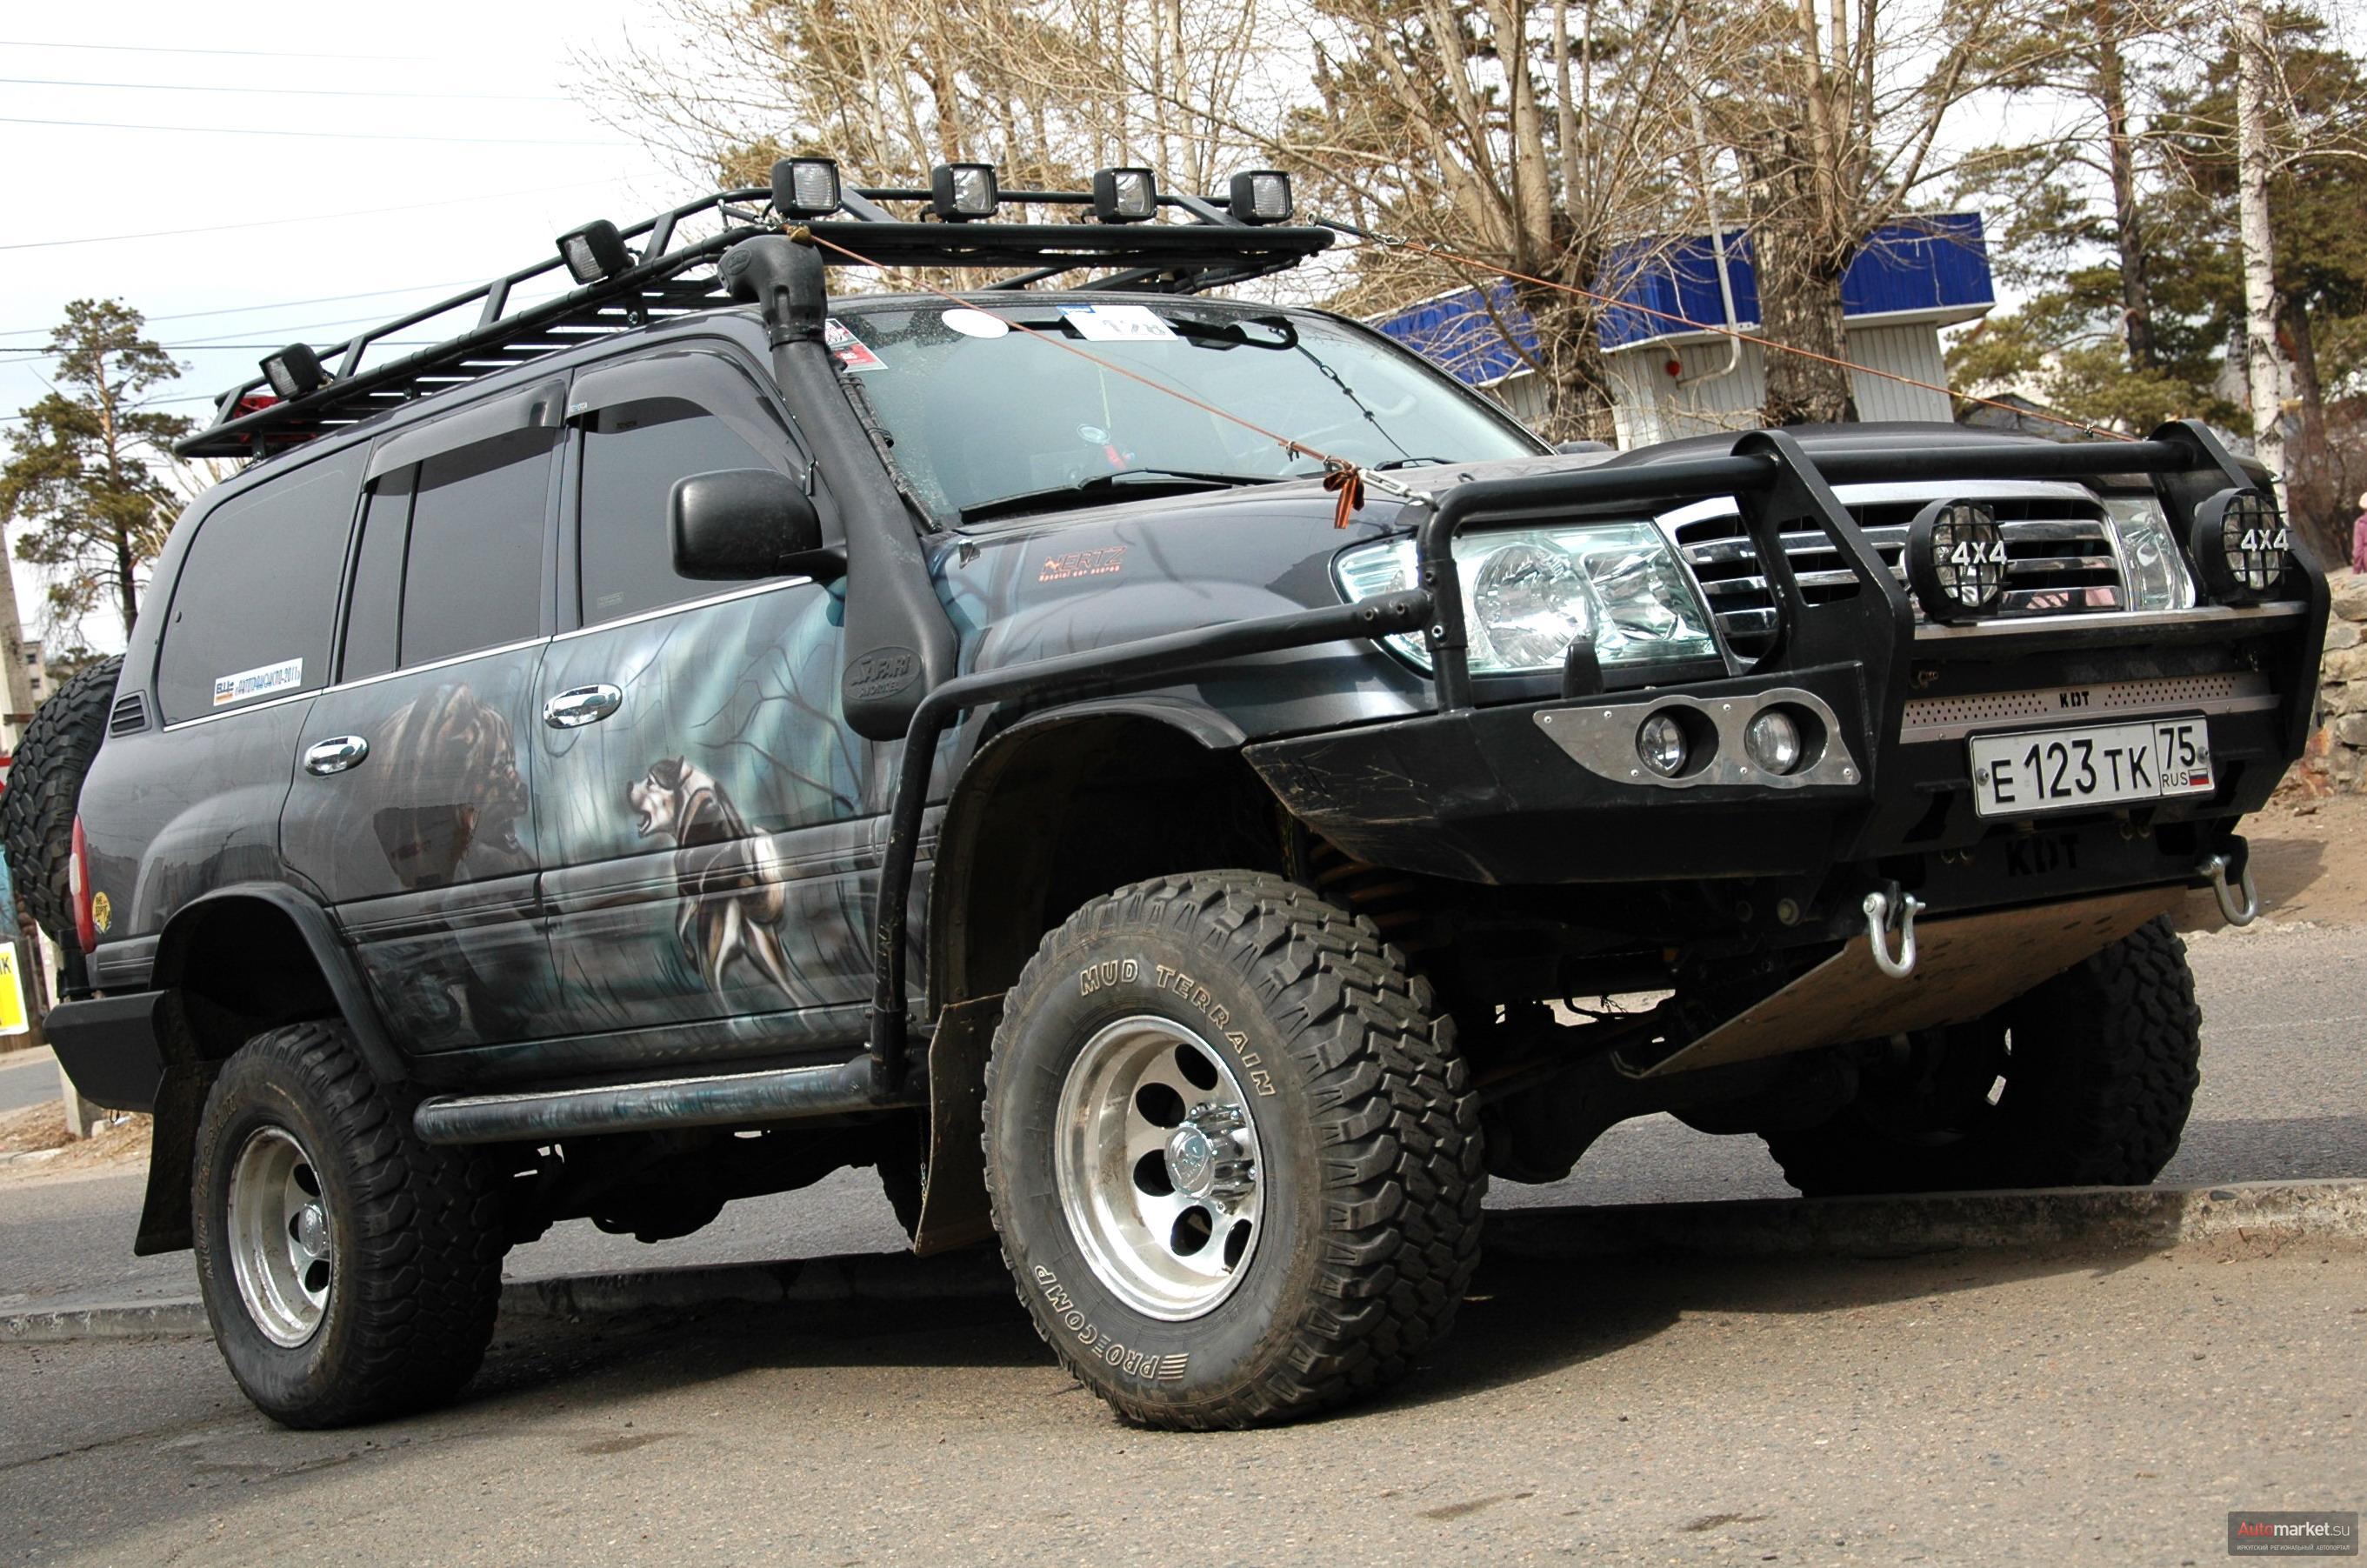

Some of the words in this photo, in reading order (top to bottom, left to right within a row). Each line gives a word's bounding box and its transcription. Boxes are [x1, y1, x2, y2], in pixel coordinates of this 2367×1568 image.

[1042, 545, 1127, 574] HERTZ
[2059, 691, 2090, 708] KDT
[2159, 725, 2196, 770] 75
[2162, 771, 2188, 787] RUS
[2004, 833, 2080, 877] KDT
[1080, 959, 1138, 997] MUD
[1156, 964, 1277, 1097] TERRAIN
